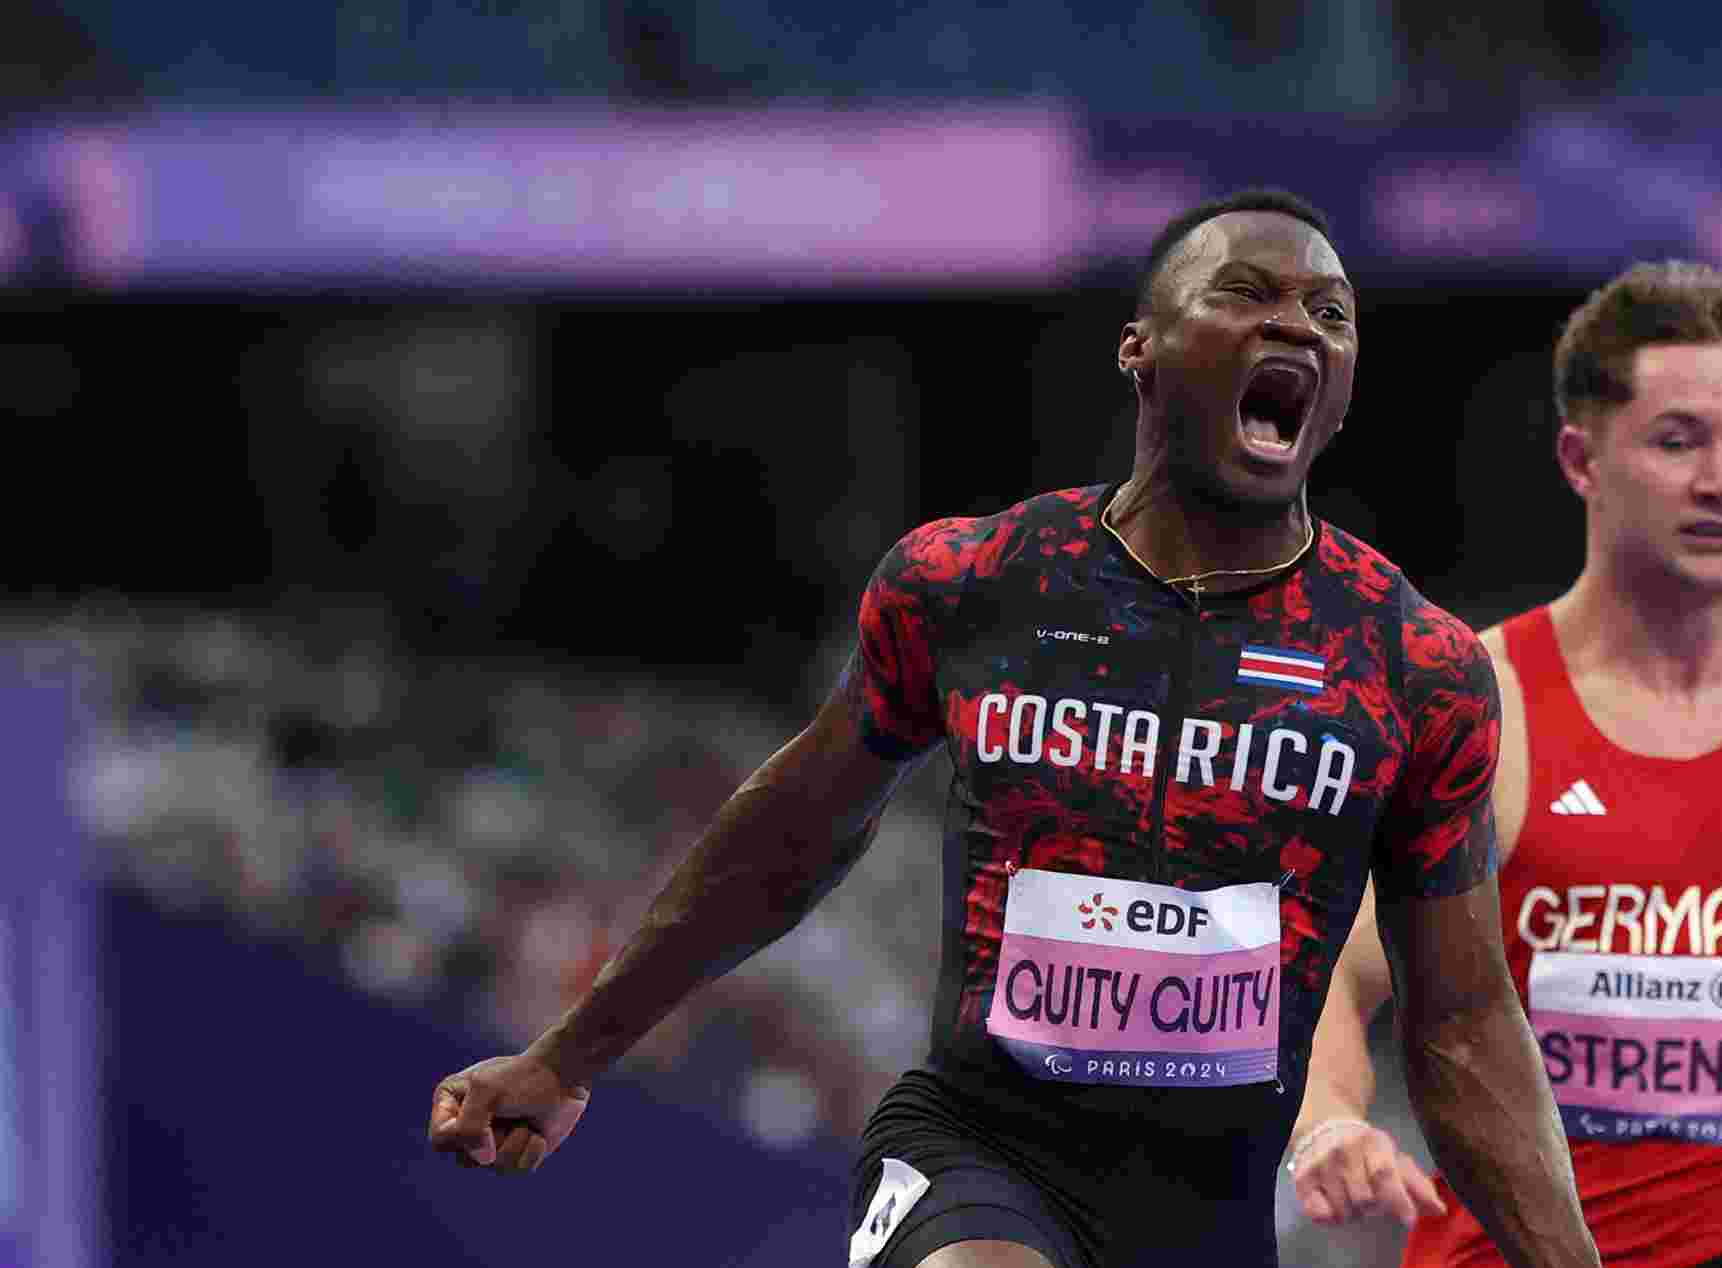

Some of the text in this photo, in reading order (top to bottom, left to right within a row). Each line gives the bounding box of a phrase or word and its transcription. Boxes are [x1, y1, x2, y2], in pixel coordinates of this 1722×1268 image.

[976, 693, 1356, 817] COSTA RICA
[1005, 959, 1275, 1034] GUITY GUITY
[1589, 971, 1702, 1003] Allianz
[1087, 1059, 1228, 1079] PARIS 2024
